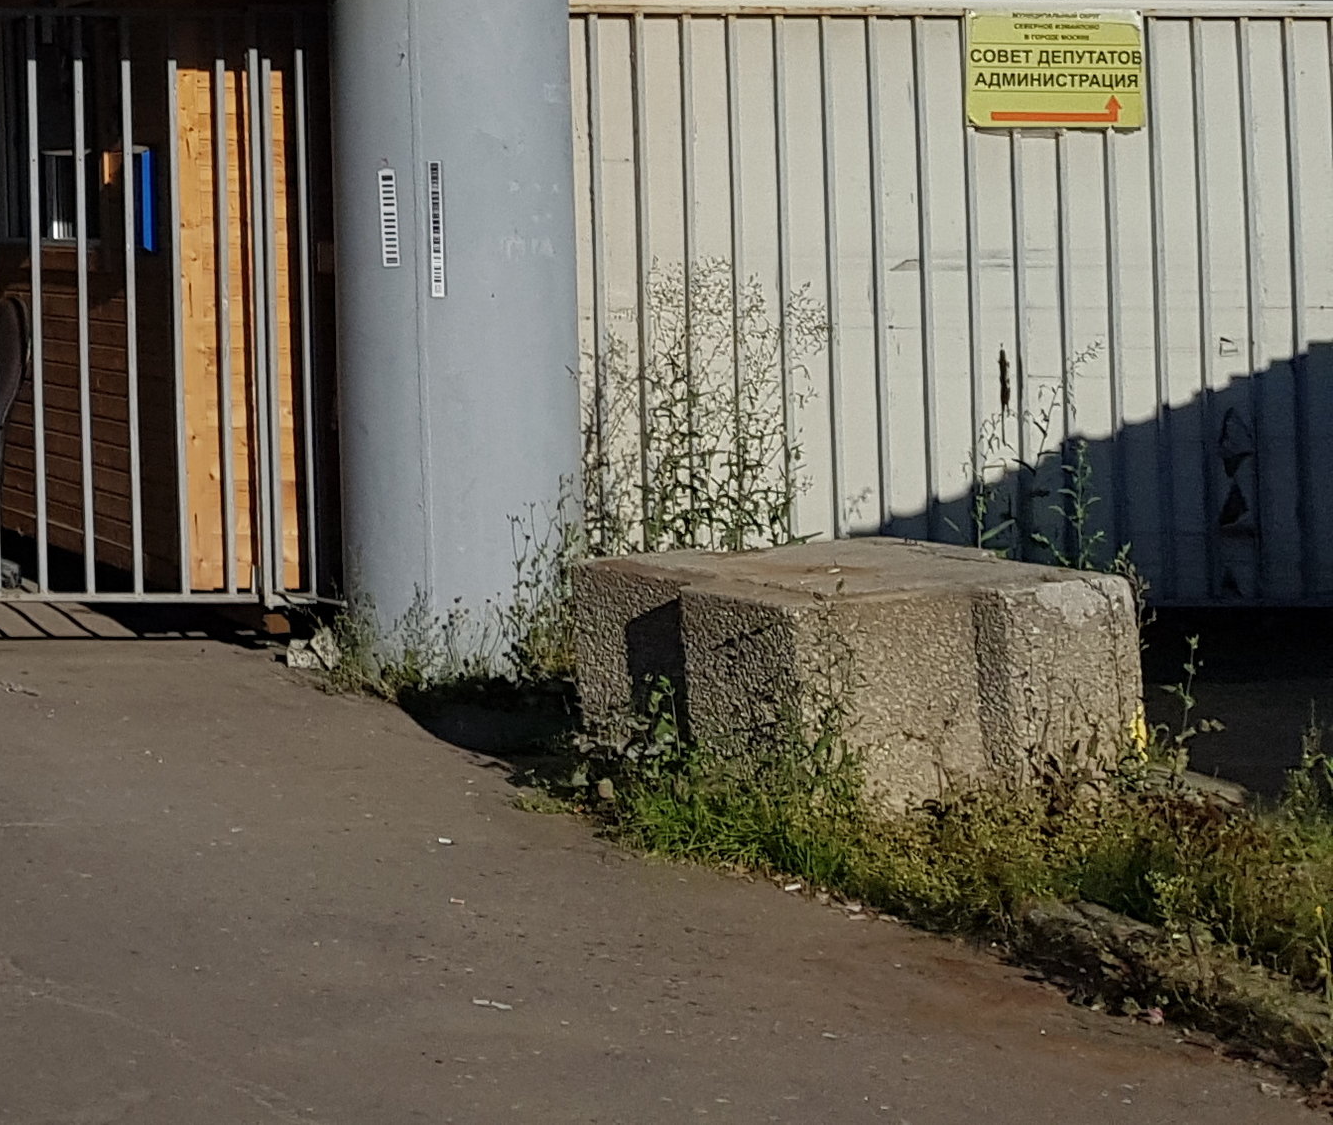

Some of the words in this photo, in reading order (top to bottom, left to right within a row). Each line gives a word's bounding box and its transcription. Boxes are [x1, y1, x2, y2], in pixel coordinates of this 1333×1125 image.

[970, 48, 1032, 63] СОВЕТ
[1037, 49, 1142, 67] ДЕПУТАТОВ
[974, 72, 1139, 90] АДМИНИСТРАЦИЯ
